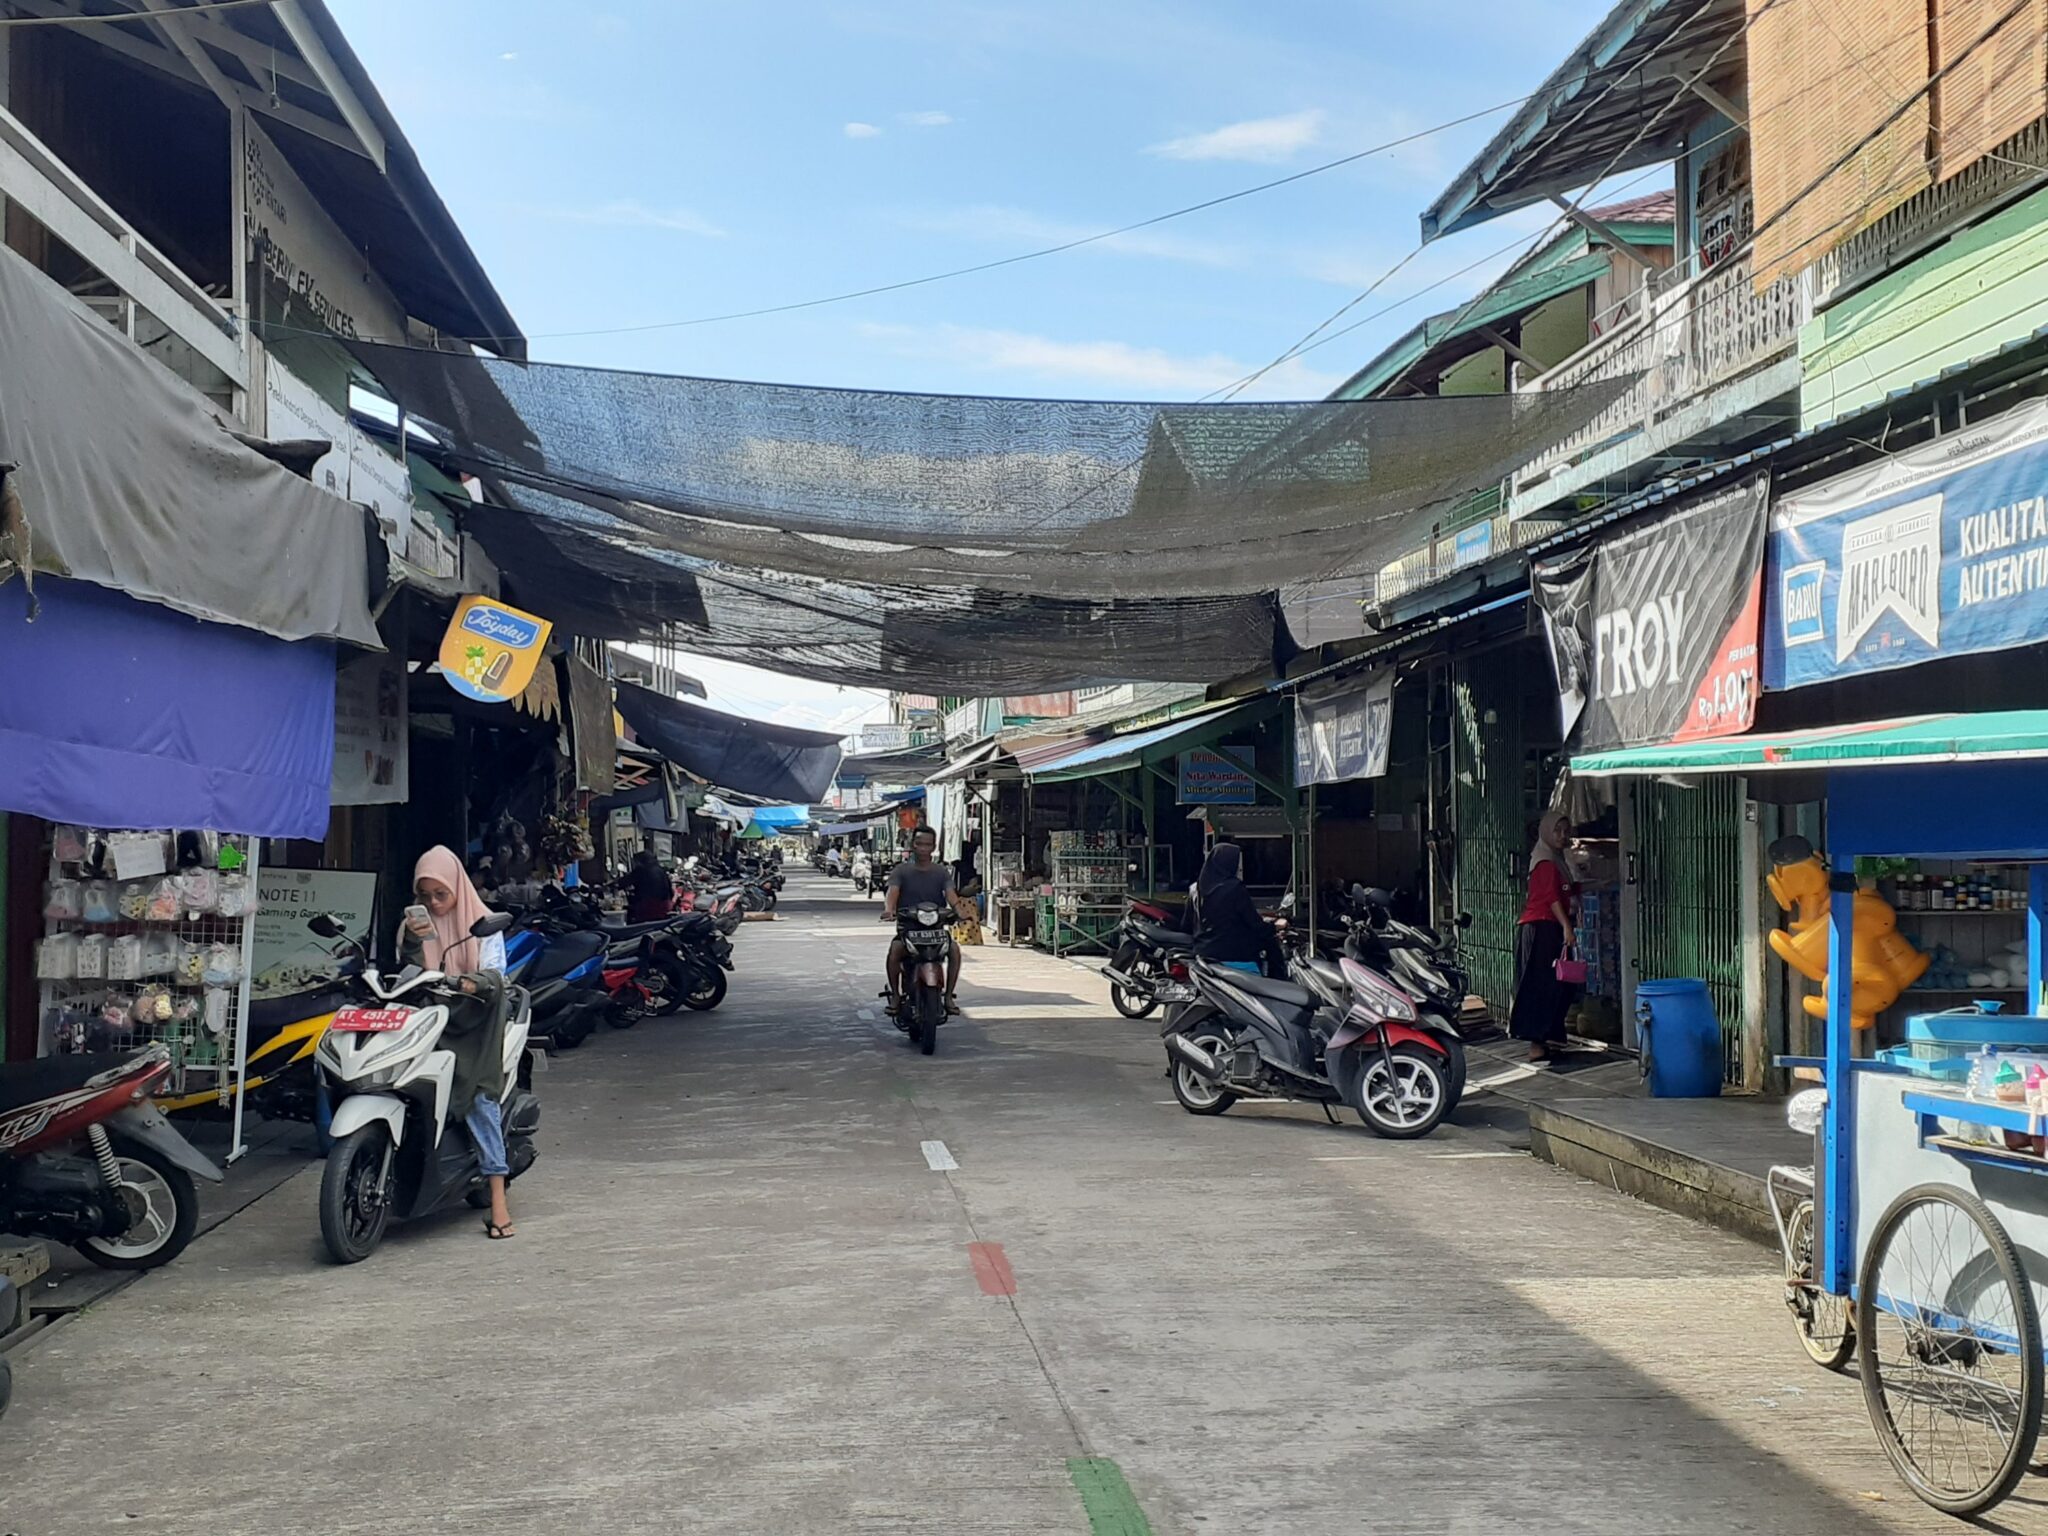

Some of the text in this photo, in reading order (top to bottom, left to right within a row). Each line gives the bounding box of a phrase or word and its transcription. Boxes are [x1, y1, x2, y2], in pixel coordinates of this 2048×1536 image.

[1948, 434, 1992, 457] PERGATAN
[1960, 495, 2048, 558] KUALITA
[1787, 581, 1818, 624] BARU
[1847, 543, 1929, 638] MARLBORO
[466, 608, 530, 645] Joyday
[256, 907, 297, 920] Gaming
[258, 888, 317, 903] NOTE 11
